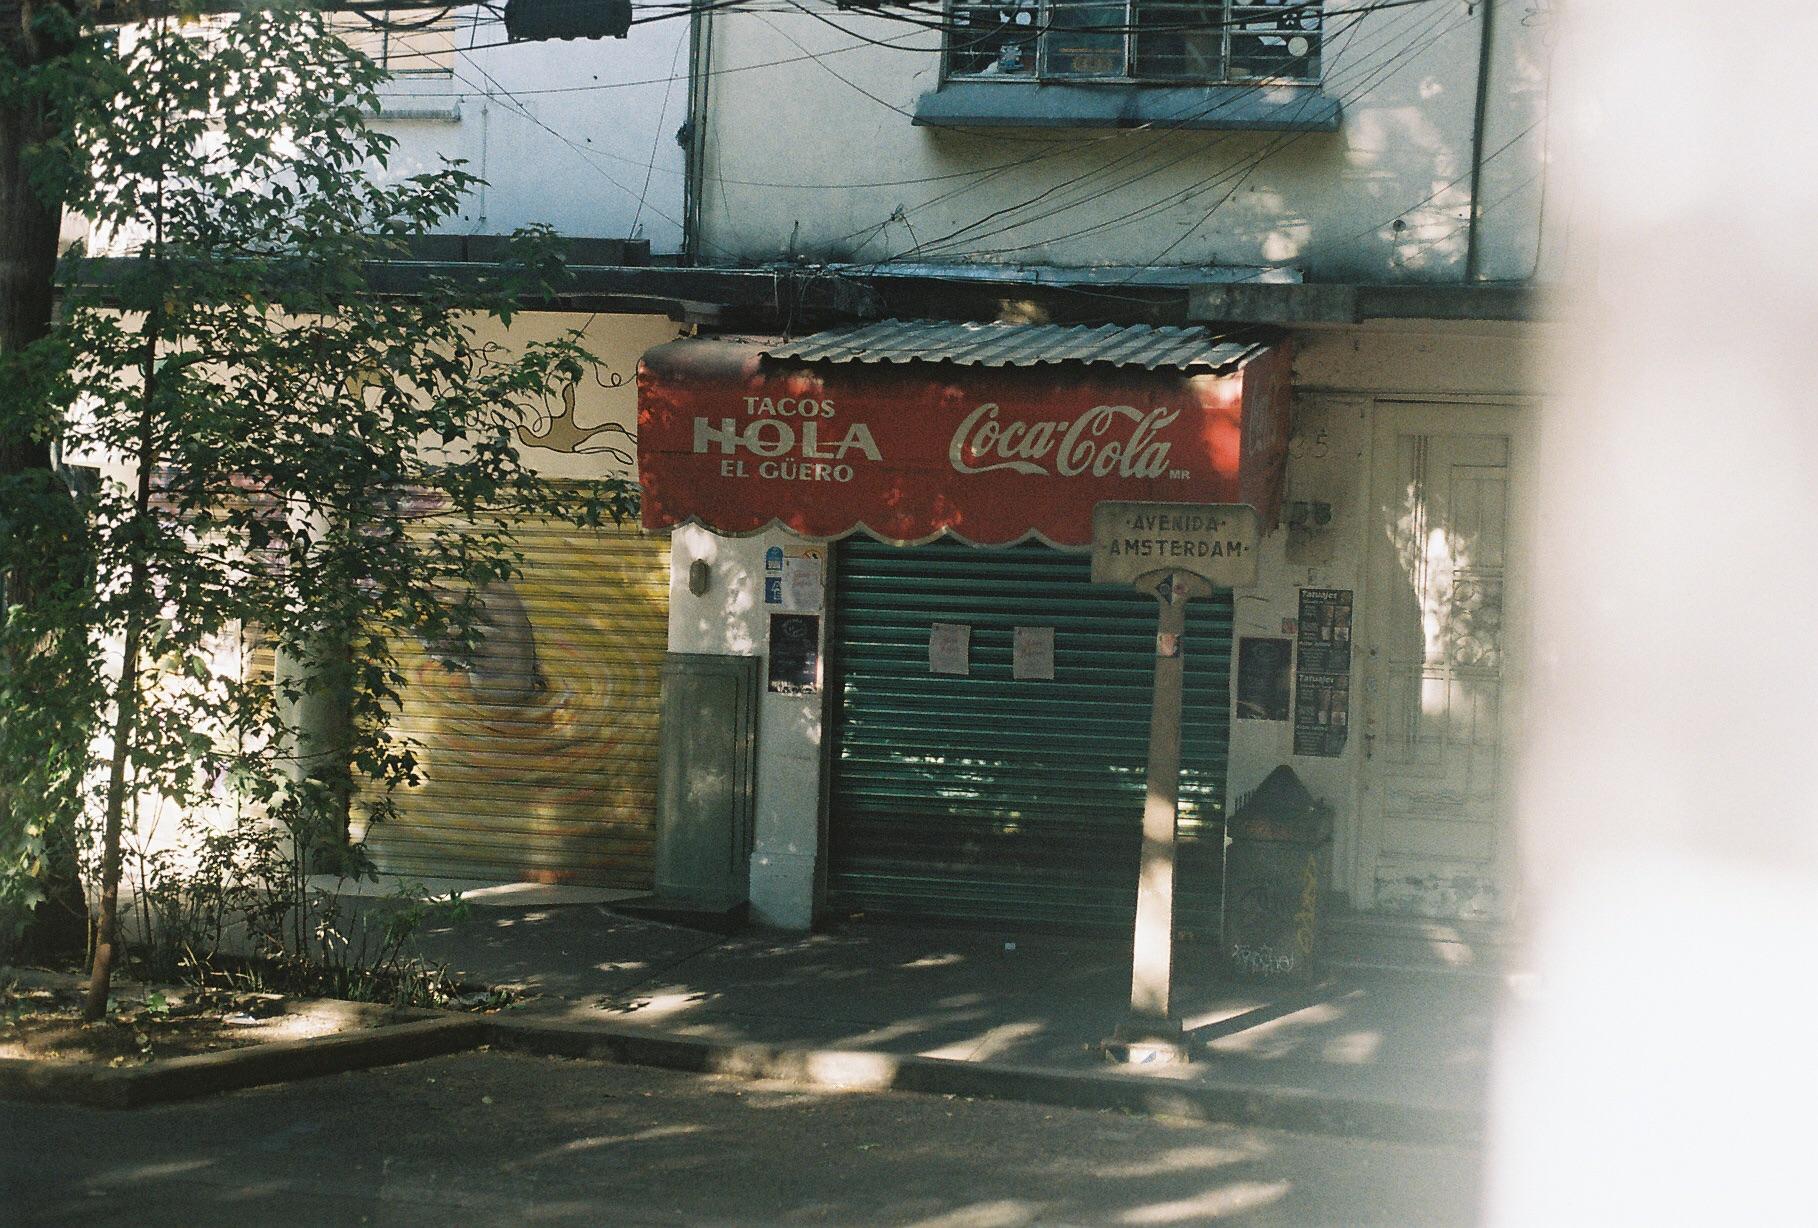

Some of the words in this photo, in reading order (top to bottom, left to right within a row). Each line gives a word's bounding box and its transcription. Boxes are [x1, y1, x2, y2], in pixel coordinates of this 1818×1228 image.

[743, 397, 836, 418] TACOS
[692, 416, 883, 461] HOLA
[948, 402, 1181, 479] Coca-Cola
[1169, 469, 1191, 481] MR
[720, 460, 750, 478] EL
[759, 458, 854, 483] GÜERO
[1132, 514, 1221, 533] AVENIDA
[1109, 538, 1243, 558] AMSTERDAM
